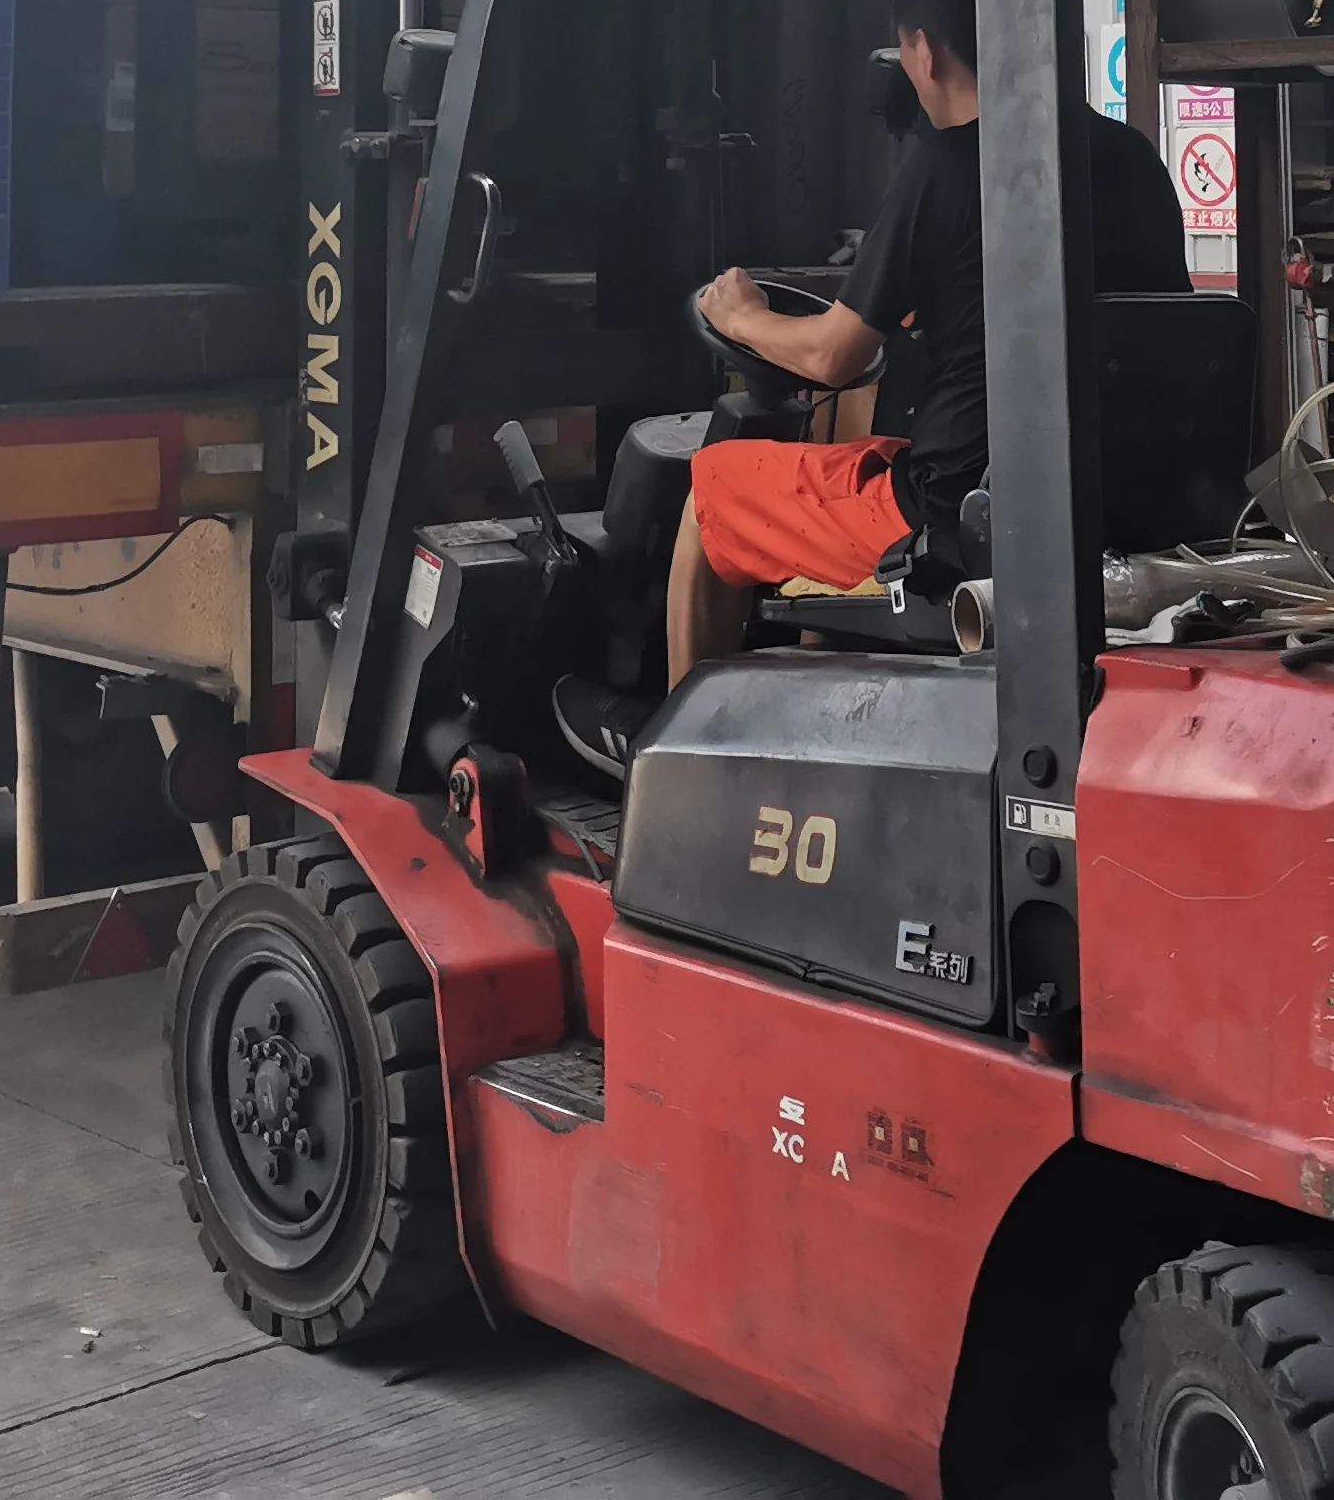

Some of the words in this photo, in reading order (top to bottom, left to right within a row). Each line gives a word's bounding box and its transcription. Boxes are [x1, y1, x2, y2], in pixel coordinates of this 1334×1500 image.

[1182, 210, 1236, 227] 禁止烟火
[306, 201, 342, 471] XGMA
[749, 805, 837, 884] 30
